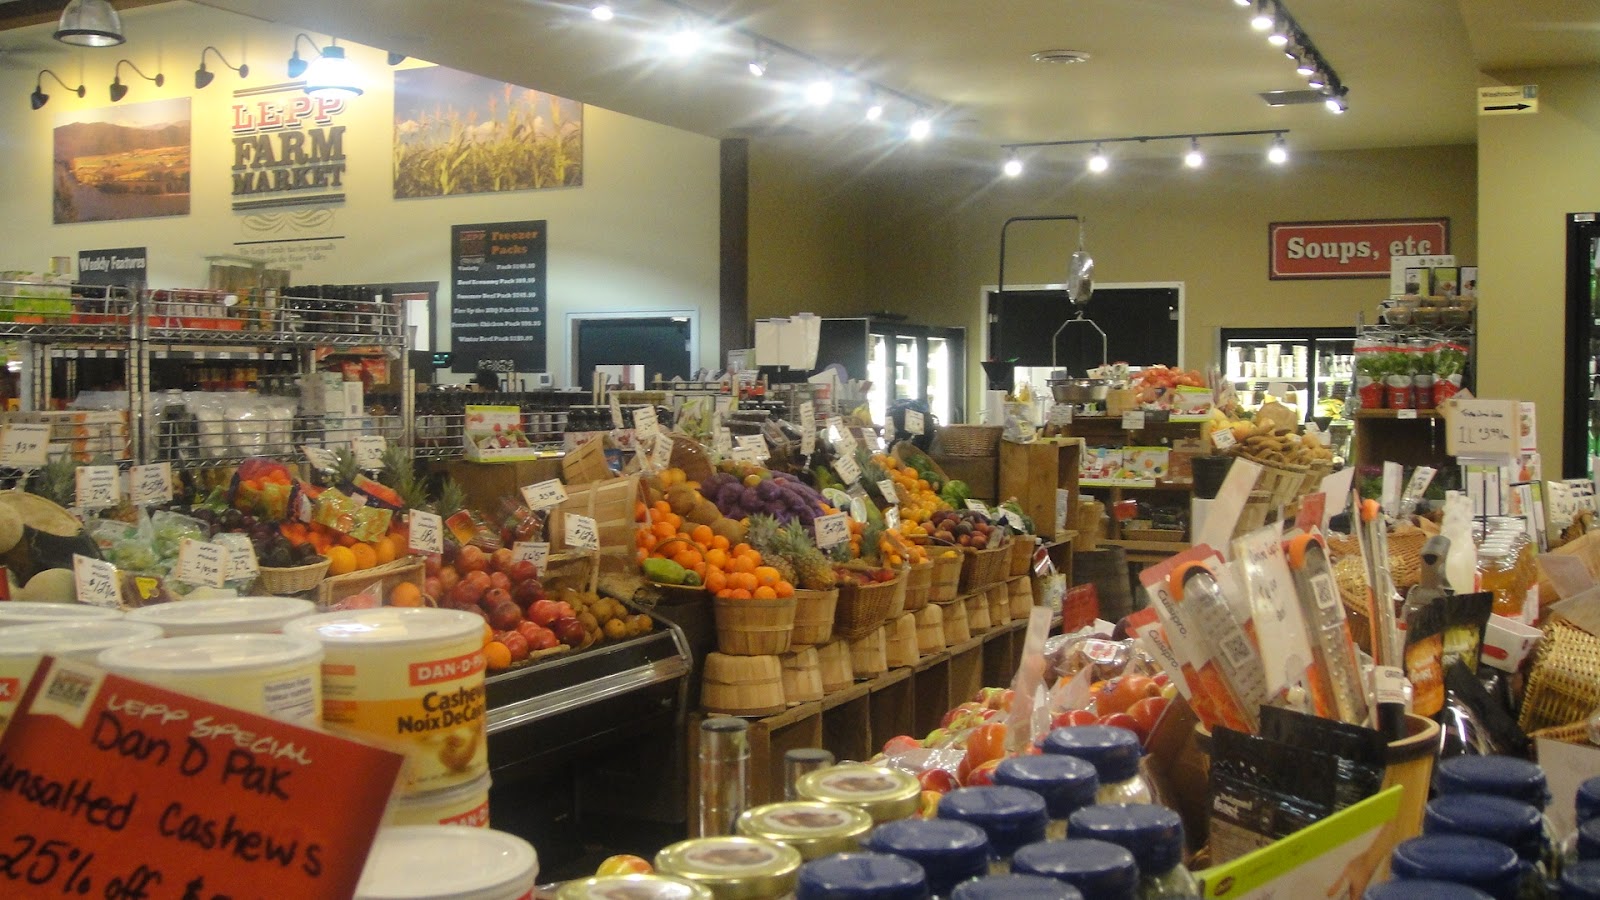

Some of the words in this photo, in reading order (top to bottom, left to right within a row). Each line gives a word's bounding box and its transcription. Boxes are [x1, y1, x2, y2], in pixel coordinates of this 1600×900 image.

[232, 97, 344, 134] LEPP
[232, 126, 346, 171] FARM
[232, 164, 346, 195] MARKET
[491, 231, 538, 240] Freezer
[491, 245, 528, 255] Packs
[1287, 236, 1380, 264] Soups,
[1389, 235, 1431, 256] etc
[80, 256, 110, 272] Weekly
[111, 256, 145, 269] Features
[418, 654, 484, 680] DAN-D-P
[107, 695, 189, 725] LEPP
[191, 716, 312, 766] SPECIAL
[91, 710, 171, 768] Dan
[180, 735, 209, 778] D
[221, 747, 292, 801] Pak
[0, 834, 94, 895] 25%
[104, 863, 163, 900] off
